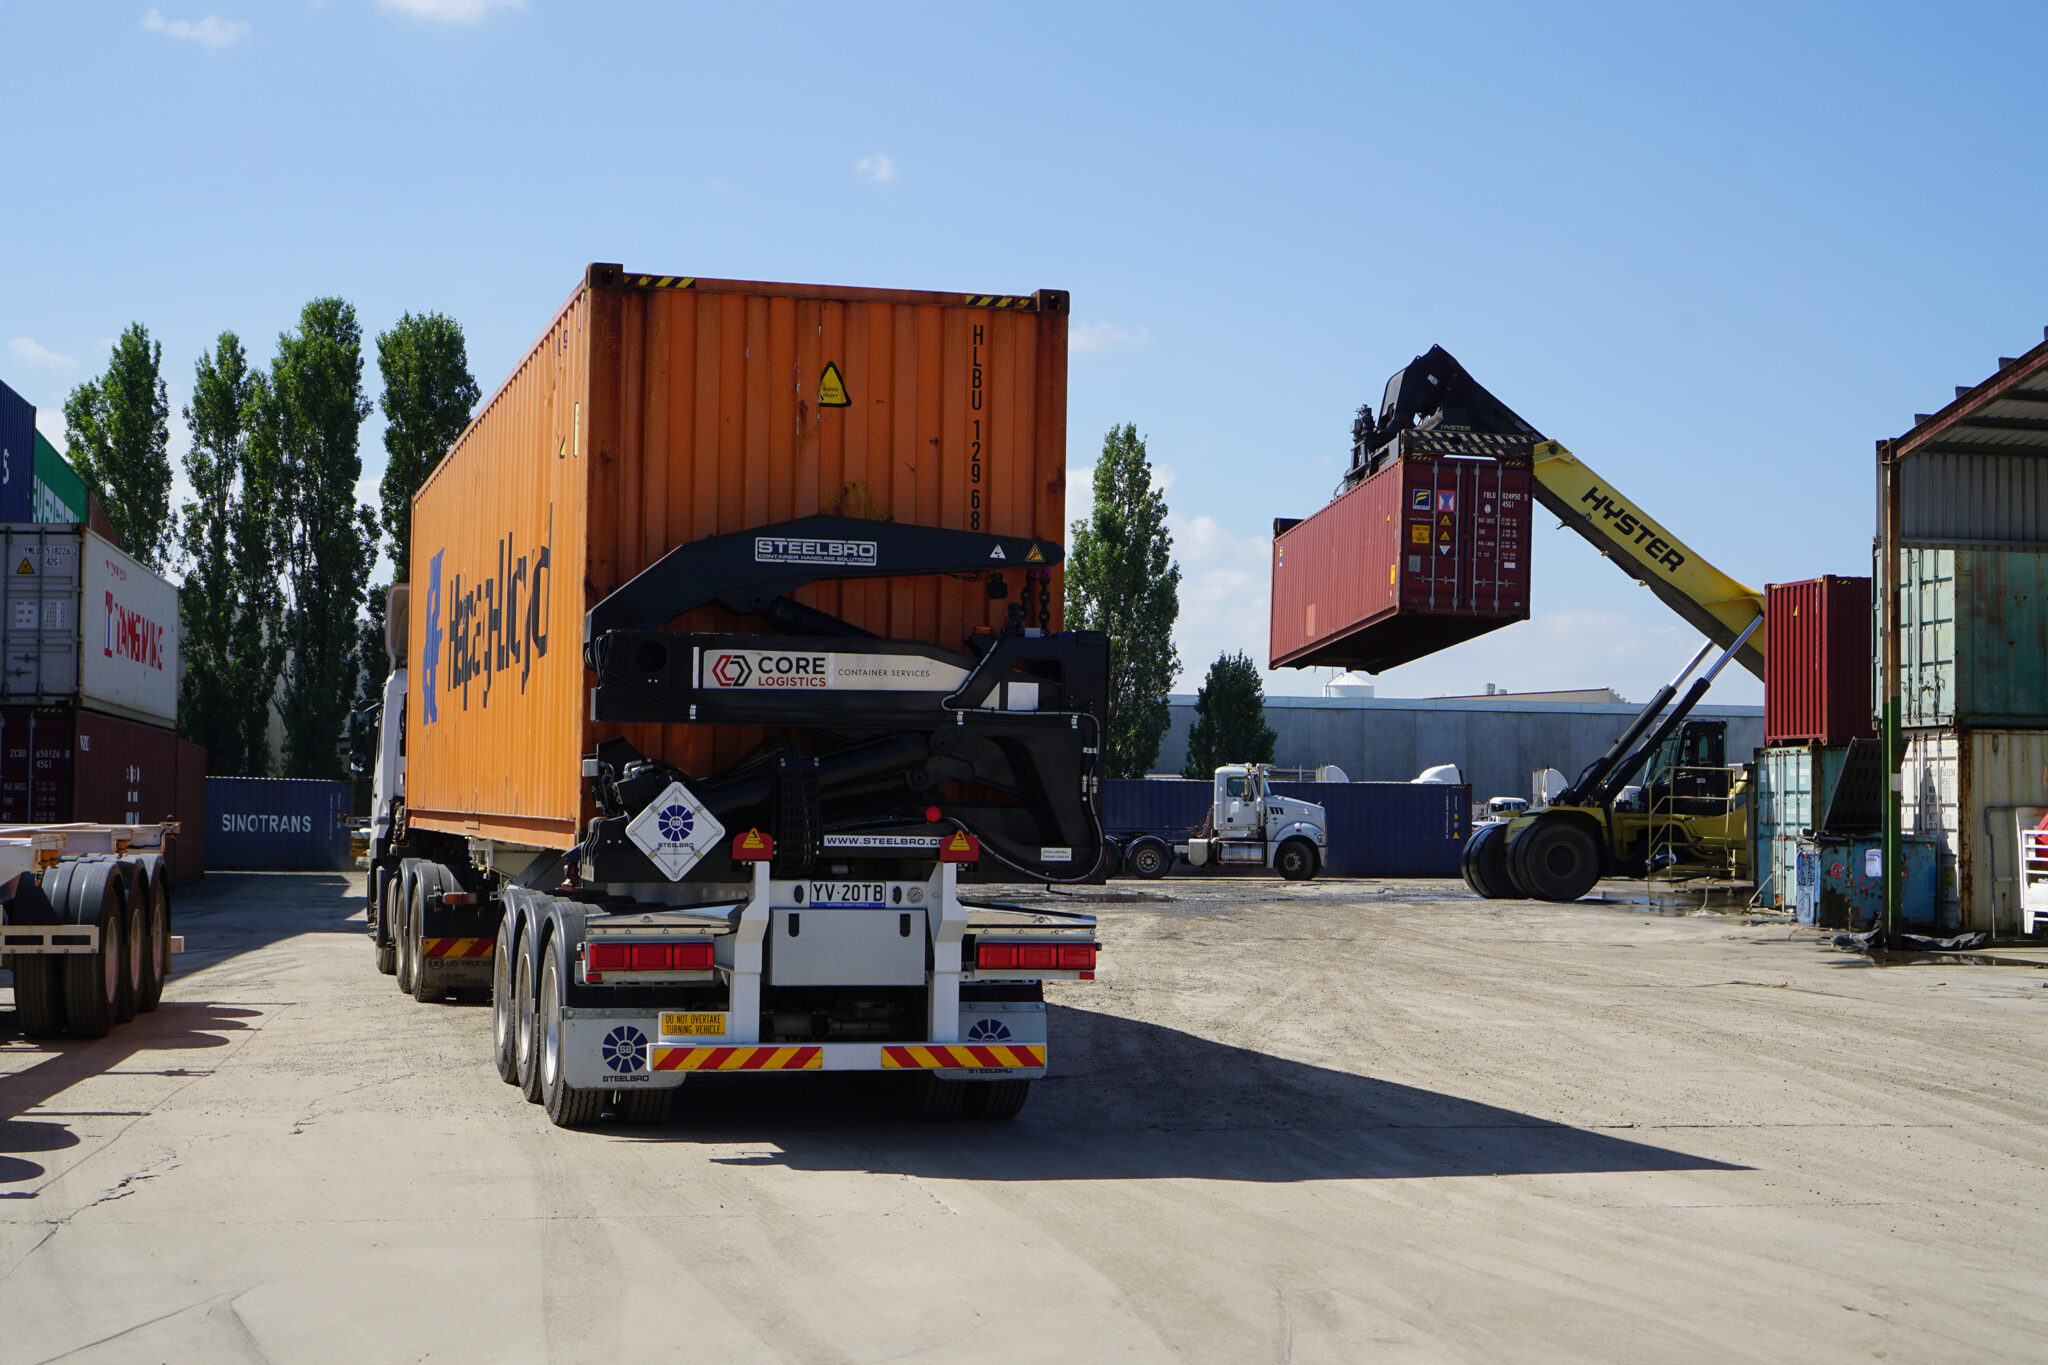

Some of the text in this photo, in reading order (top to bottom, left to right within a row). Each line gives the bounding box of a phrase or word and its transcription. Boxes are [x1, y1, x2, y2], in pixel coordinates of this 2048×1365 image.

[972, 324, 984, 411] HLBU
[1483, 491, 1496, 499] FBLU
[1502, 493, 1521, 501] 024950
[1580, 486, 1686, 573] HYSTER
[758, 540, 875, 557] STEELBRO
[758, 656, 826, 675] CORE
[838, 669, 931, 678] CONTAINER SERVICES
[758, 677, 826, 687] LOGISTICS
[222, 814, 312, 833] SINOTRANS
[665, 1014, 721, 1024] DO NOT OVERTAKE
[666, 1024, 721, 1034] TURNING VEHICLE
